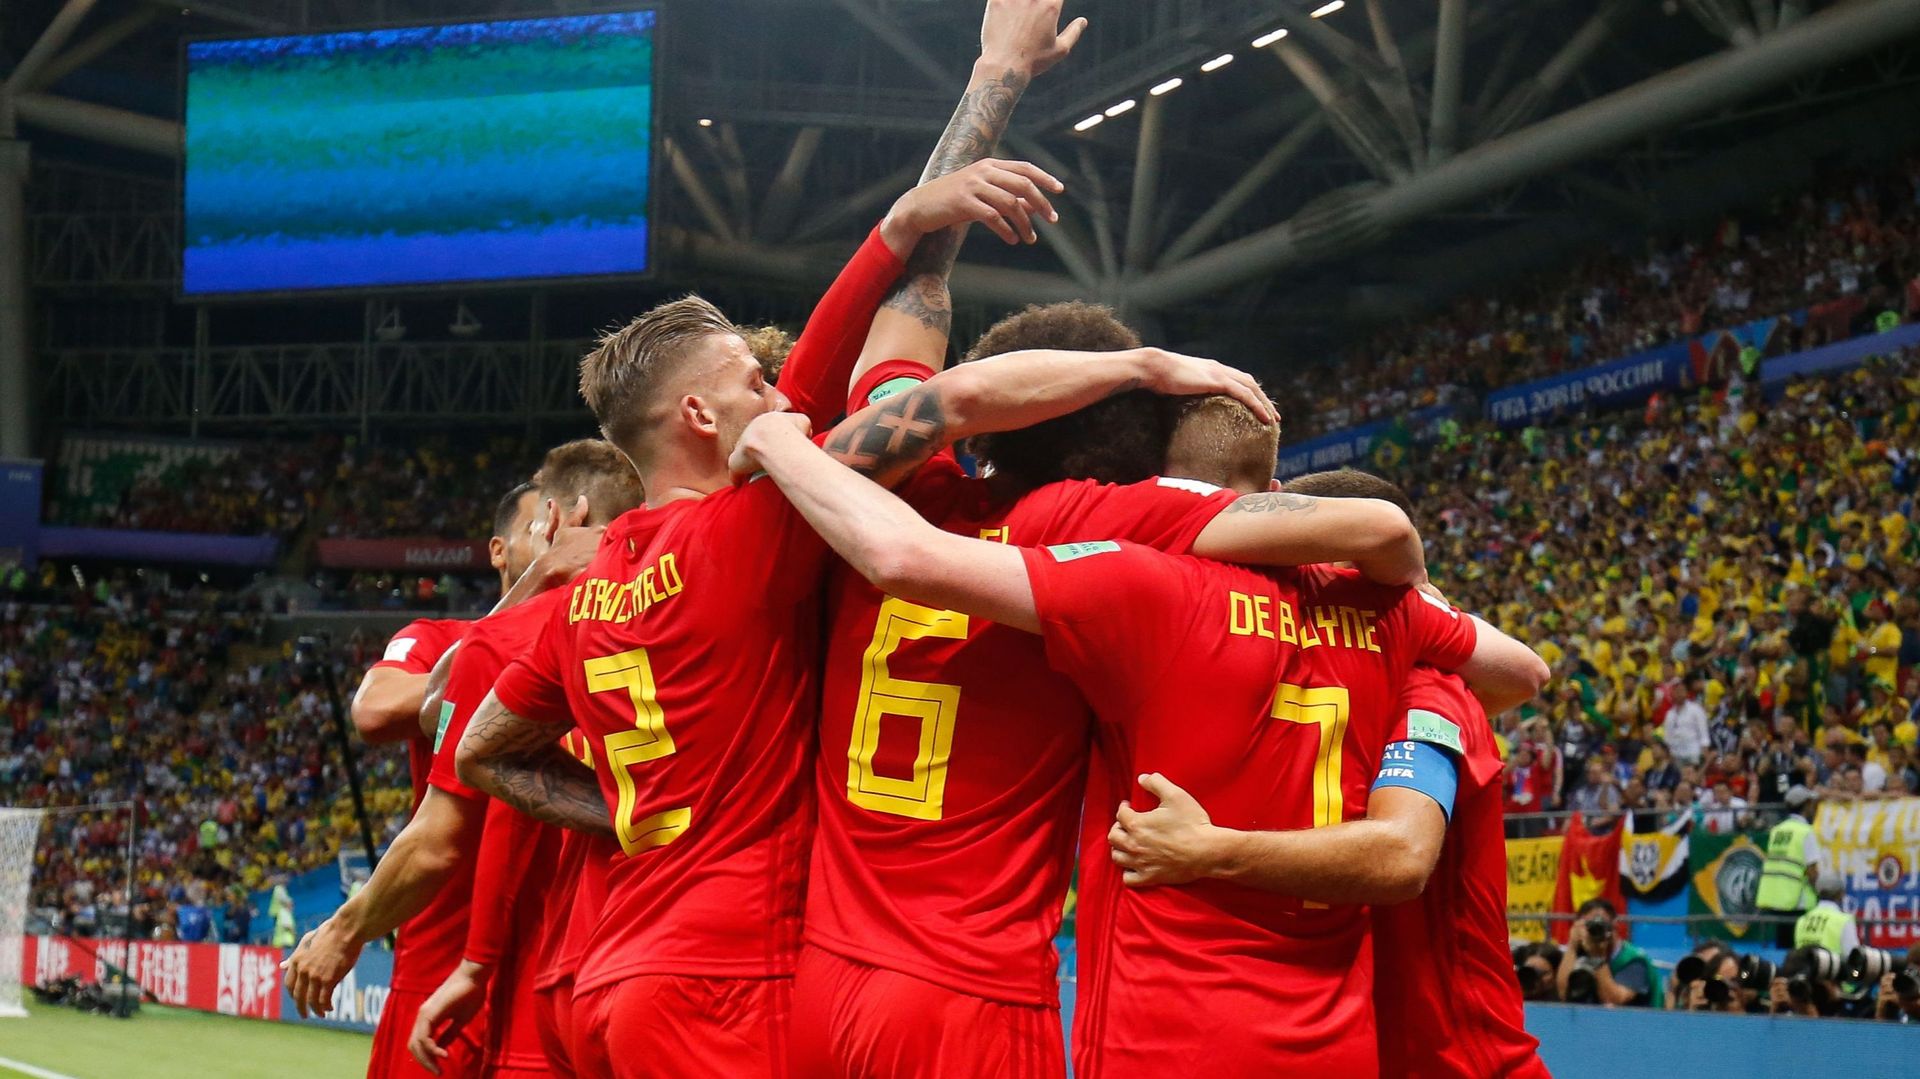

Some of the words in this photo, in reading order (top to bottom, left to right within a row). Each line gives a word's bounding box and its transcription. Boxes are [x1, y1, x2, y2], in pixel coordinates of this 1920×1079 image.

[1229, 591, 1276, 640] DE
[1279, 600, 1382, 654] BUYNE
[583, 647, 692, 858] 2
[846, 594, 970, 822] 6
[1270, 682, 1350, 829] 7
[1378, 767, 1415, 779] FIFA
